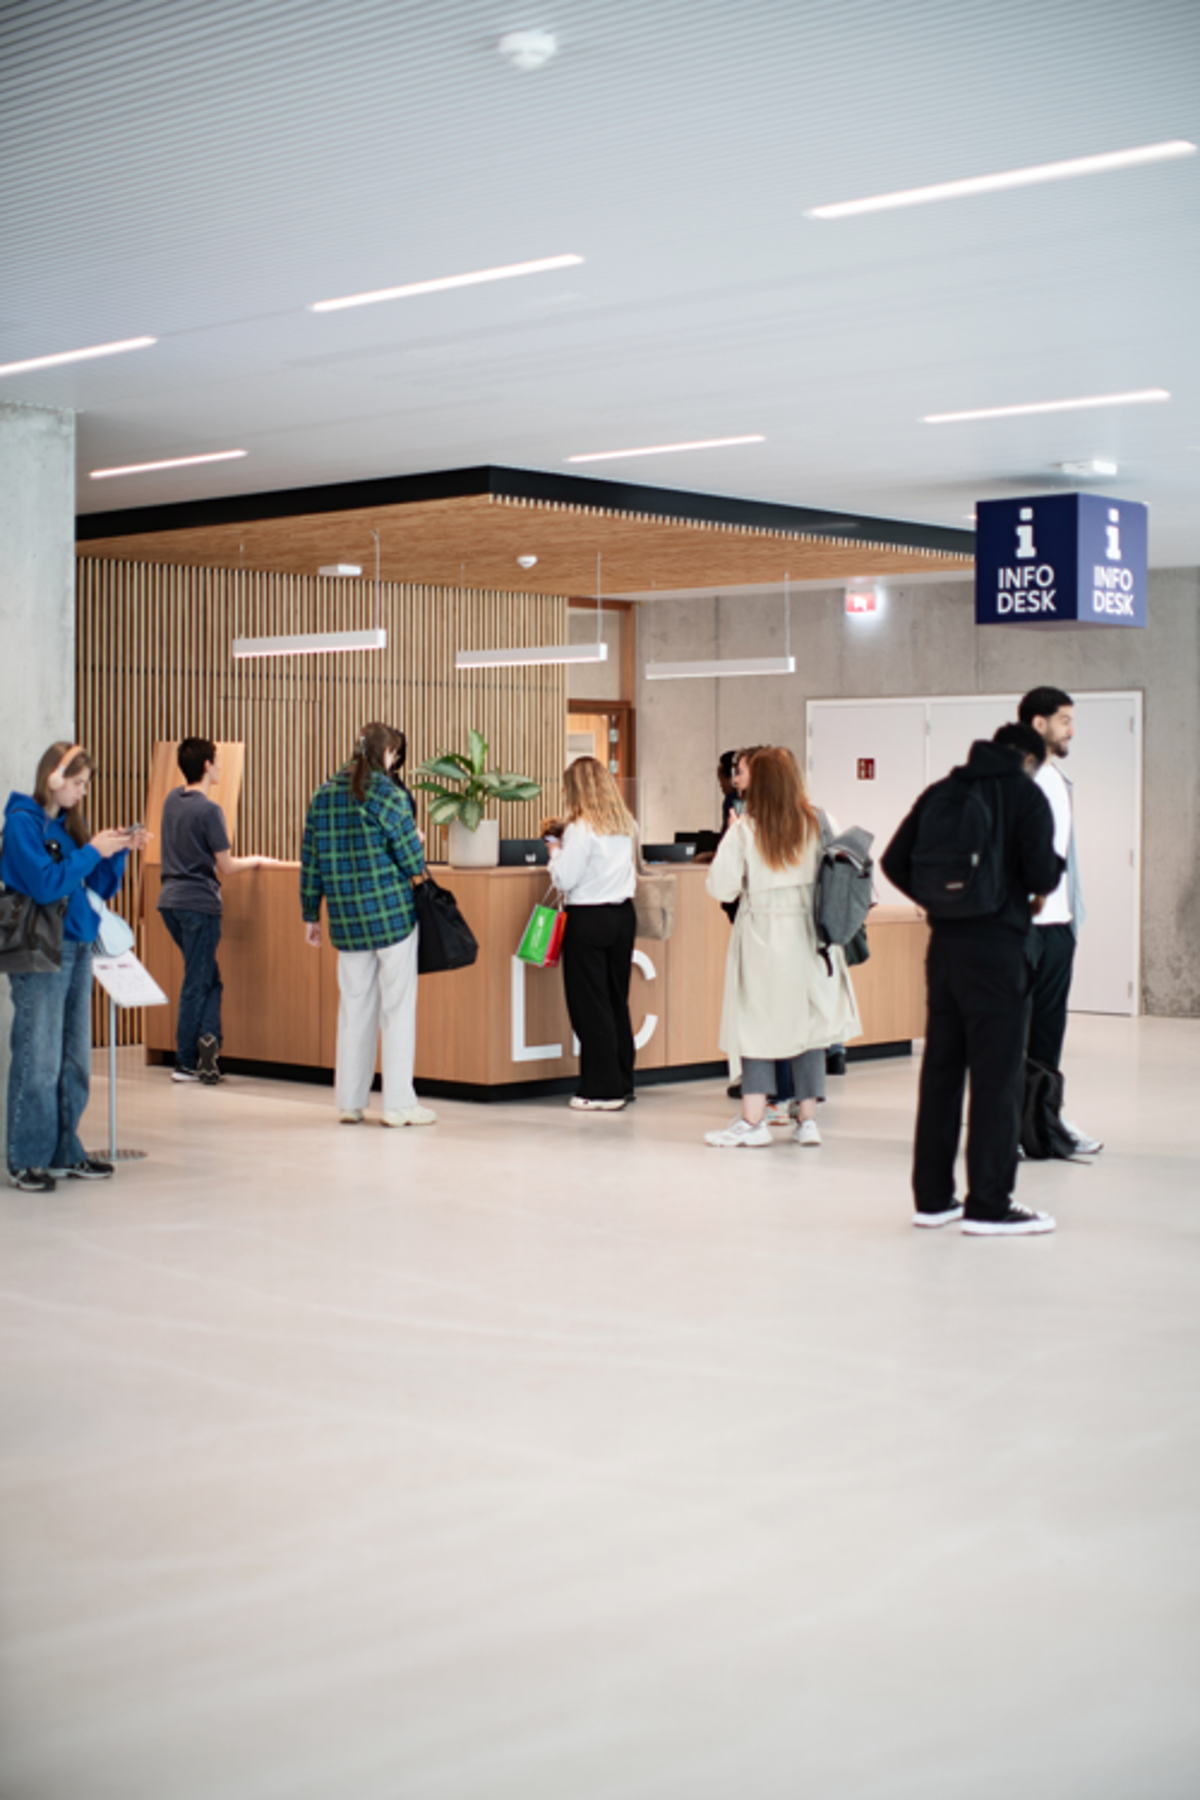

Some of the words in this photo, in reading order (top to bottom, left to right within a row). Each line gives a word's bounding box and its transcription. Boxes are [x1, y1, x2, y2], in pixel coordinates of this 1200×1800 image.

[998, 564, 1055, 589] INFO
[1093, 565, 1133, 591] INFO
[997, 589, 1056, 614] DESK
[1093, 589, 1134, 616] DESK
[511, 949, 658, 1062] LC
